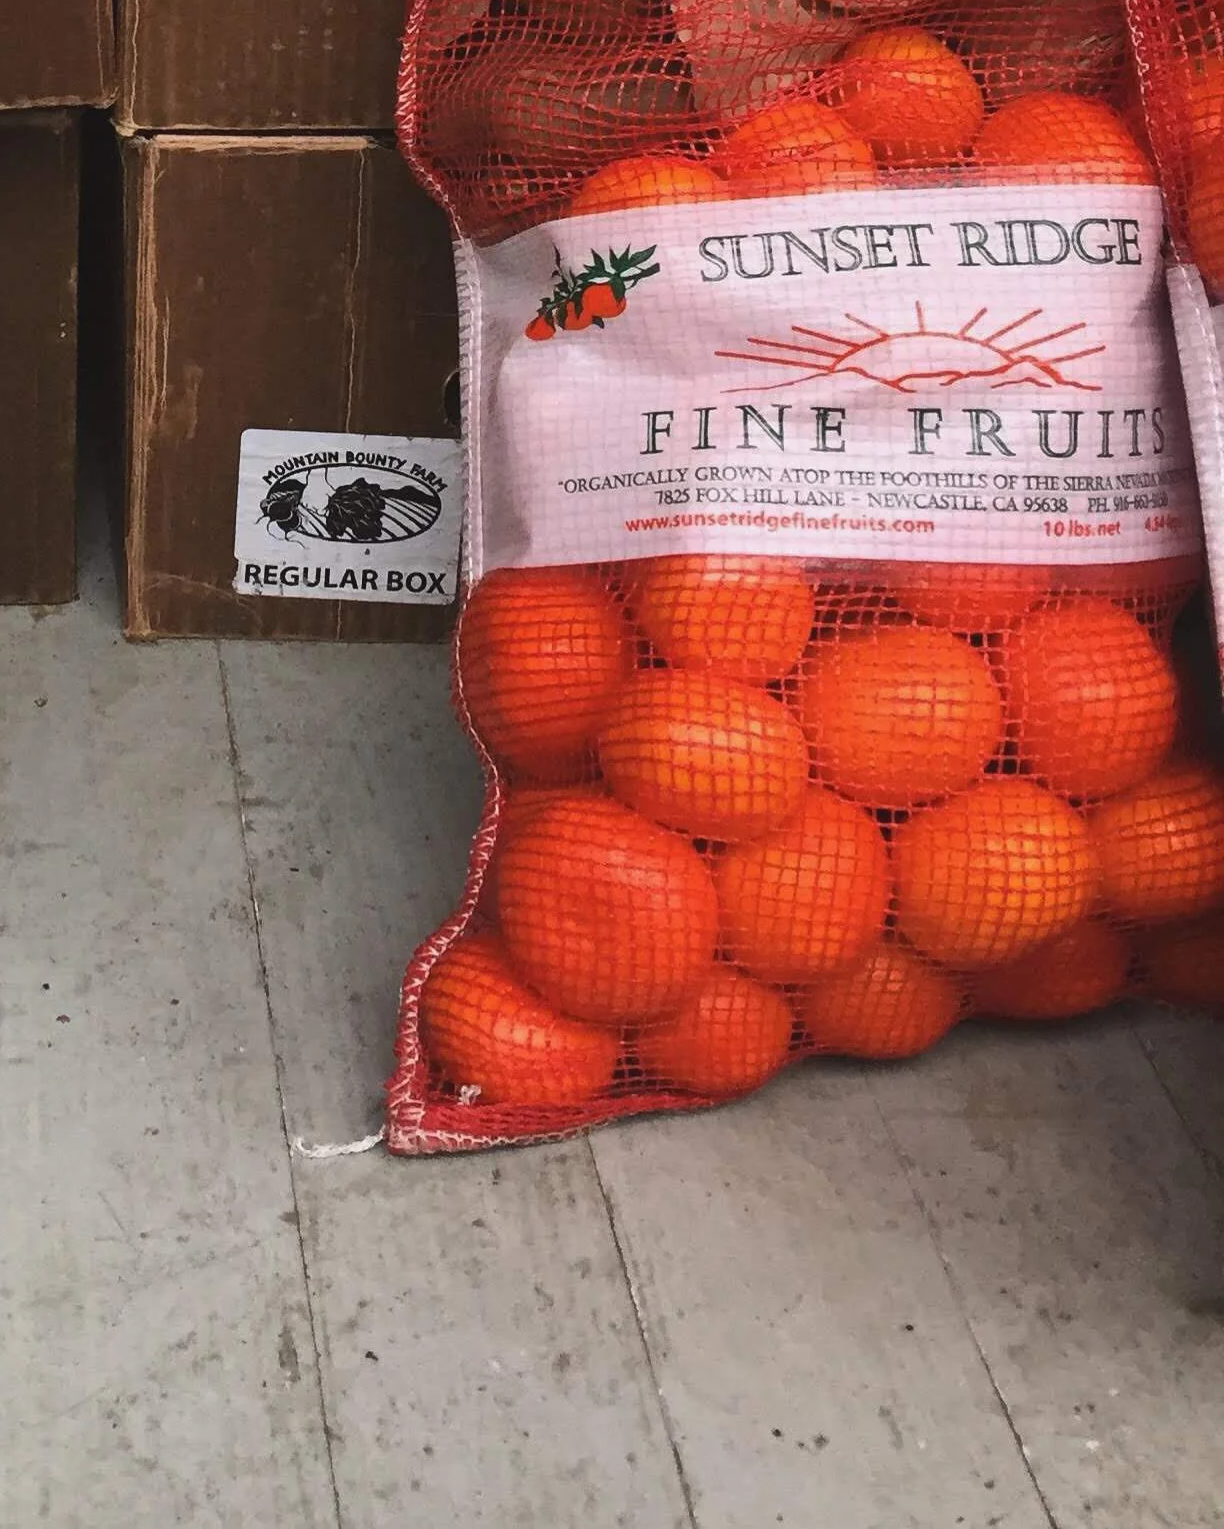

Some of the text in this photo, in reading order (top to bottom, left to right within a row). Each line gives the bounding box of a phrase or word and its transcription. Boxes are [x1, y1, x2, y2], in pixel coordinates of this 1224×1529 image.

[699, 218, 1143, 283] SUNSET RIDGE
[639, 404, 1166, 460] FINE FRUITS
[262, 451, 449, 493] MOUNTAIN BOUNTY FARM
[694, 466, 773, 482] GROWN
[779, 468, 831, 485] ATOP
[835, 470, 876, 486] THE
[880, 471, 988, 489] FOOTHILLS
[992, 473, 1019, 489] OF
[1024, 475, 1060, 491] THE
[1063, 475, 1113, 491] SIERRA
[655, 488, 691, 505] 7825
[695, 487, 738, 503] FOX
[742, 488, 789, 505] HILL
[794, 490, 846, 507] LANE
[992, 496, 1019, 512] CA
[625, 509, 935, 534] www.sunsetridgefinefruits.com
[1043, 521, 1064, 537] 10
[244, 564, 448, 595] REGULAR BOX
